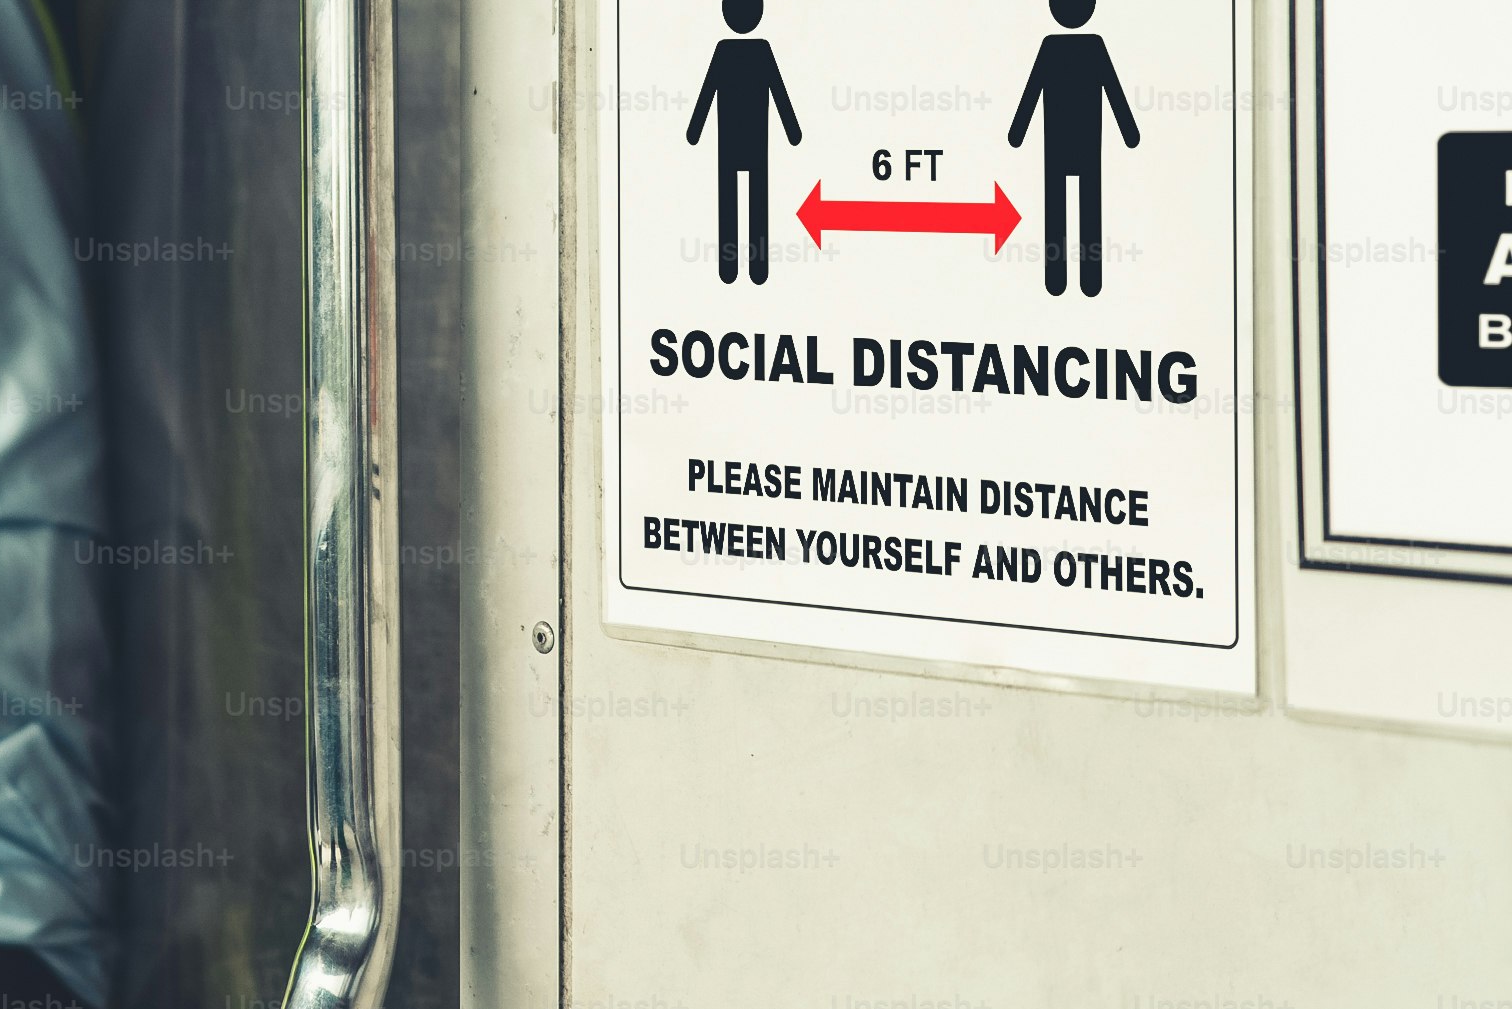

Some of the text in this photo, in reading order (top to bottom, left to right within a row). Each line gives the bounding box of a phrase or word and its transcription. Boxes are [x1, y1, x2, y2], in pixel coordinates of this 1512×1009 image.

[872, 149, 944, 182] 6 FT
[649, 328, 1198, 405] SOCIAL DISTANCING
[688, 458, 1149, 527] PLEASE MAINTAIN DISTANCE
[642, 515, 1204, 599] BETWEEN YOURSELF AND OTHERS.
